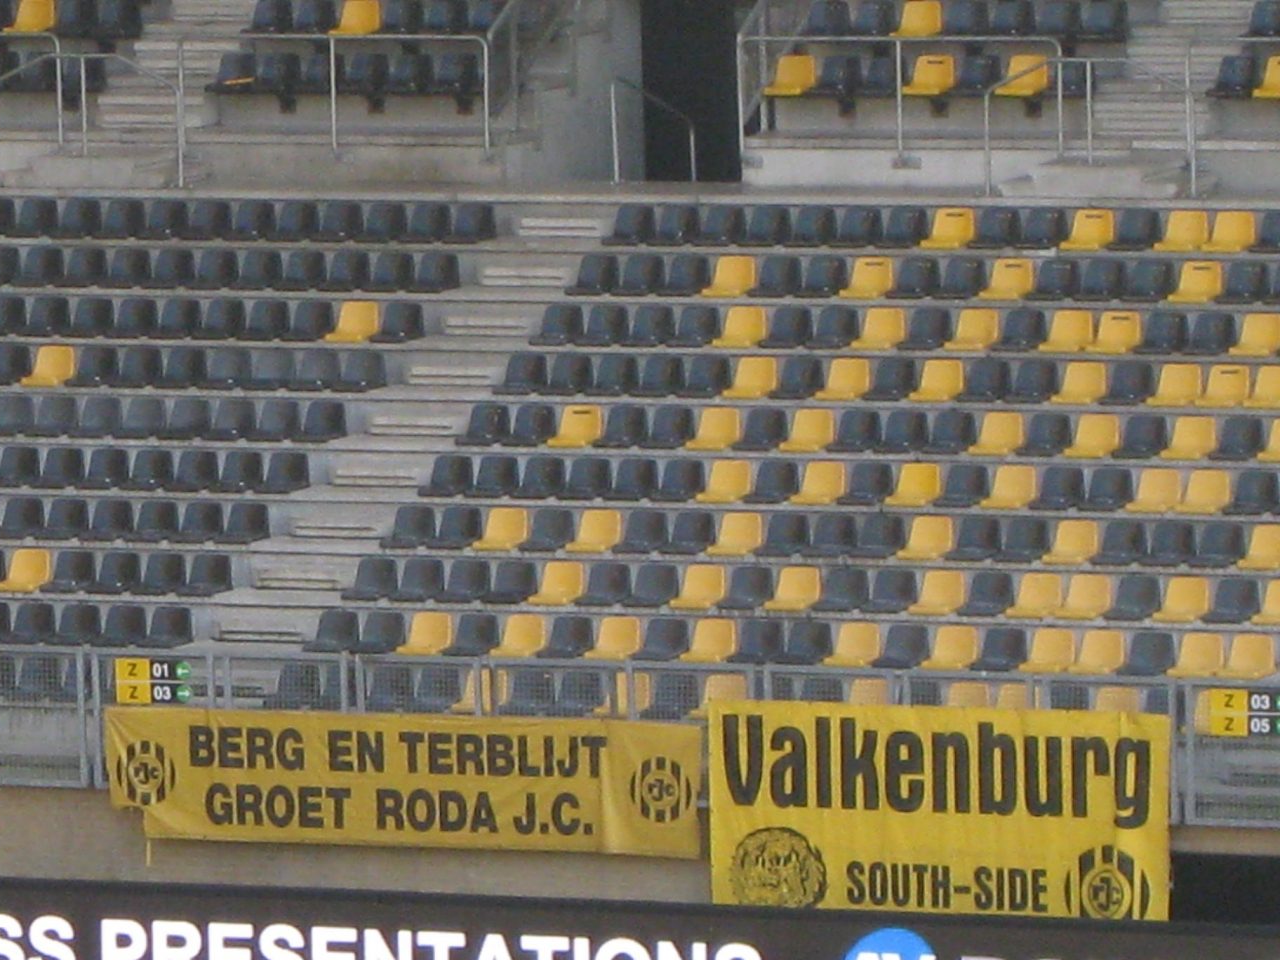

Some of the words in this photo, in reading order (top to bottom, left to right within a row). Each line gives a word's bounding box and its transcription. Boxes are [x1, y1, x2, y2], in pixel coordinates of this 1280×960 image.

[127, 663, 138, 676] Z
[152, 662, 169, 678] 01
[128, 686, 139, 699] Z
[153, 685, 172, 700] 03
[1224, 694, 1234, 708] Z
[1250, 693, 1271, 710] 03
[1224, 717, 1234, 731] Z
[1250, 717, 1271, 733] 05
[188, 724, 305, 771] BERG
[327, 729, 385, 773] EN
[399, 731, 607, 778] TERBLIJT
[722, 713, 1152, 830] Valkenburg
[204, 782, 352, 829] GROET
[375, 787, 499, 833] RODA
[513, 791, 594, 835] J.C.
[846, 860, 1048, 912] SOUTH-SIDE
